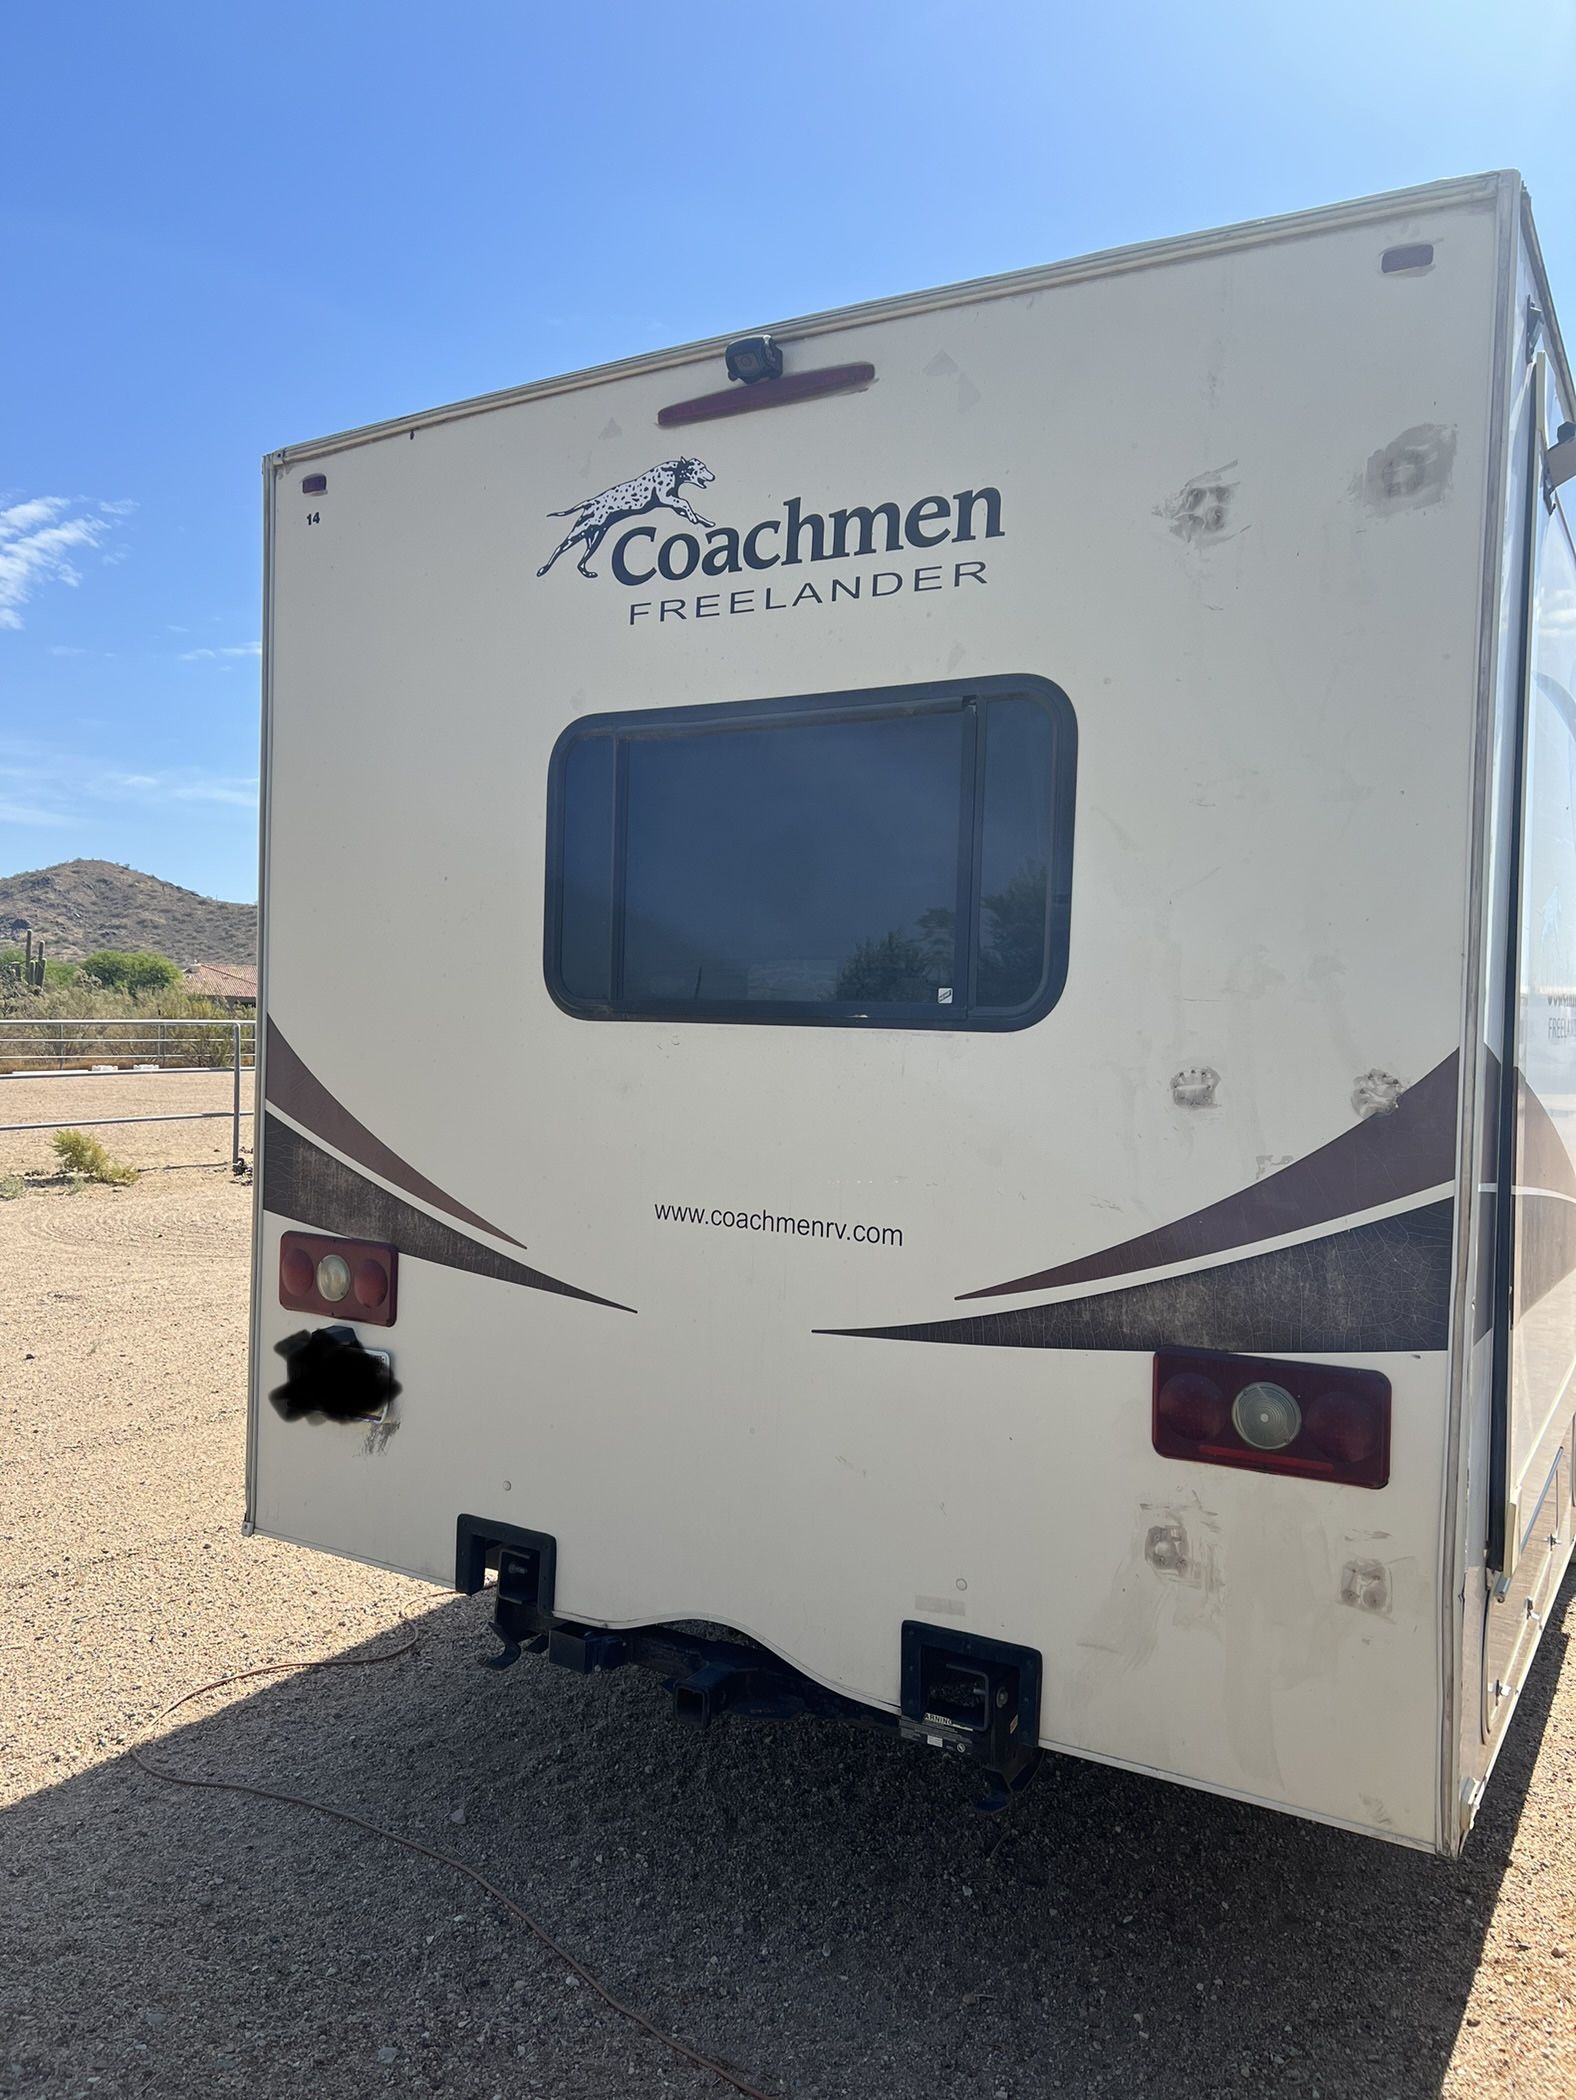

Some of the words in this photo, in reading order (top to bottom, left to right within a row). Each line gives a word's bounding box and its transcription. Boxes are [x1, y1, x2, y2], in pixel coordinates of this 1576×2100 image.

[306, 511, 320, 525] 14
[611, 486, 1005, 586] Coachmen
[629, 561, 988, 625] FREELANDER
[654, 1203, 903, 1247] www.coachmenrv.com
[924, 1712, 952, 1726] ARNING
